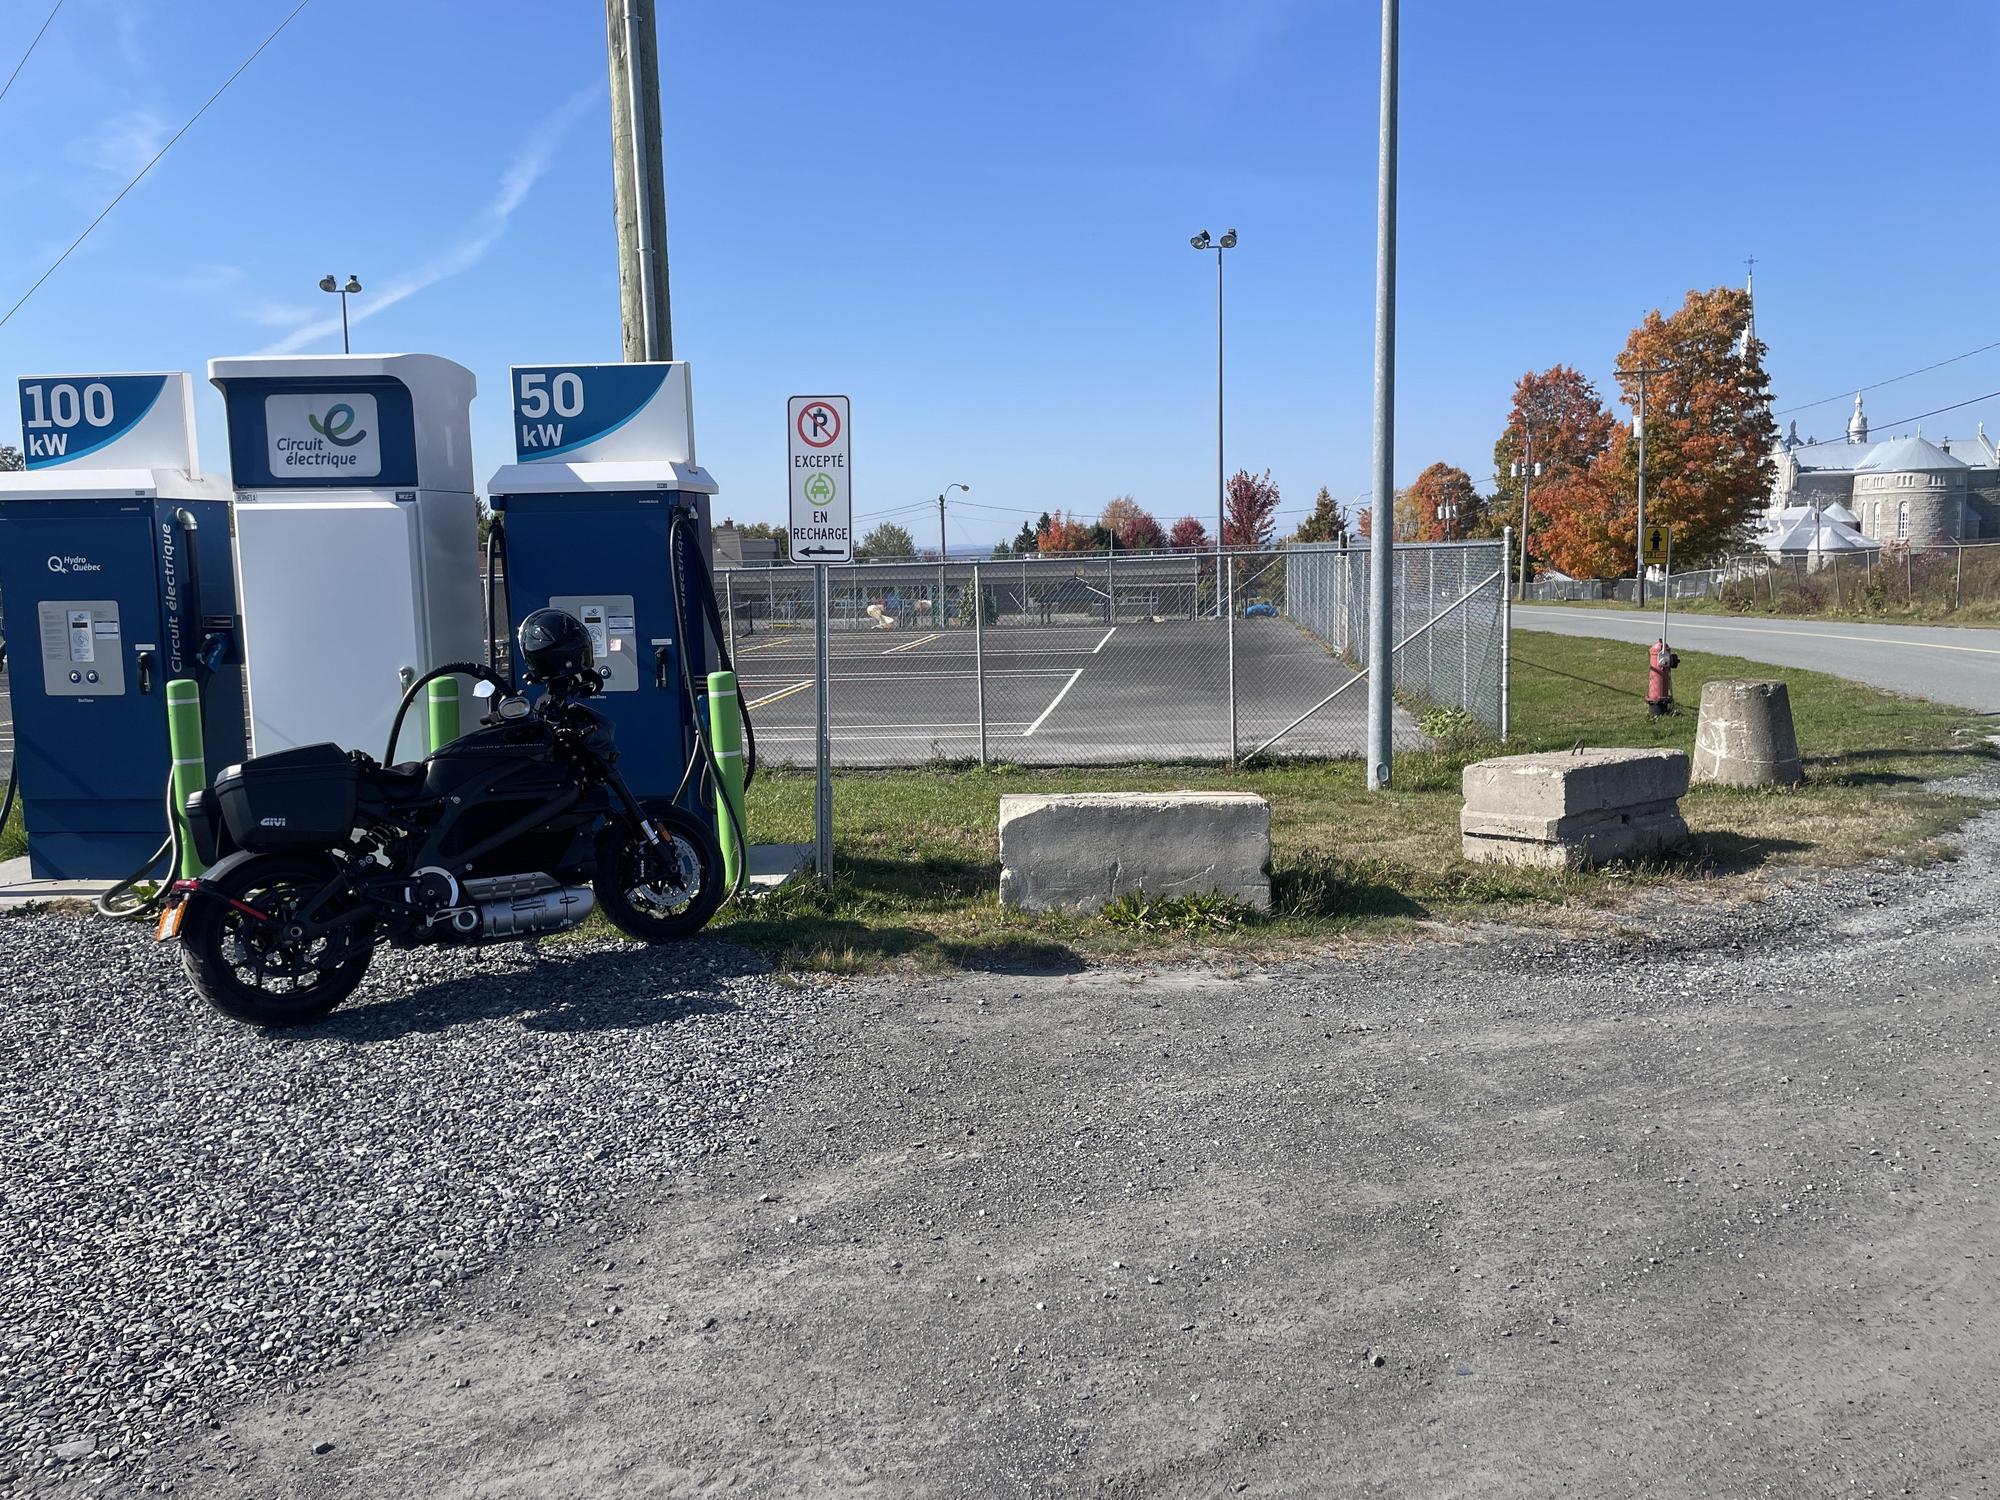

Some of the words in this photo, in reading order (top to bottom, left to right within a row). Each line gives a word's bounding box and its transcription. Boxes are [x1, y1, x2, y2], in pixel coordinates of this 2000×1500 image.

[520, 372, 585, 419] 50
[25, 383, 115, 428] 100
[522, 423, 564, 447] kW
[29, 433, 68, 456] kW
[276, 437, 324, 451] Circuit
[285, 452, 357, 468] électrique
[794, 453, 844, 468] EXCEPTÉ
[813, 511, 828, 523] EN
[793, 527, 848, 540] RECHARGE
[63, 556, 87, 565] Hydro
[72, 563, 101, 571] Québec
[162, 523, 177, 611] électrique
[166, 615, 182, 673] Circuit
[260, 817, 286, 827] GIVI
